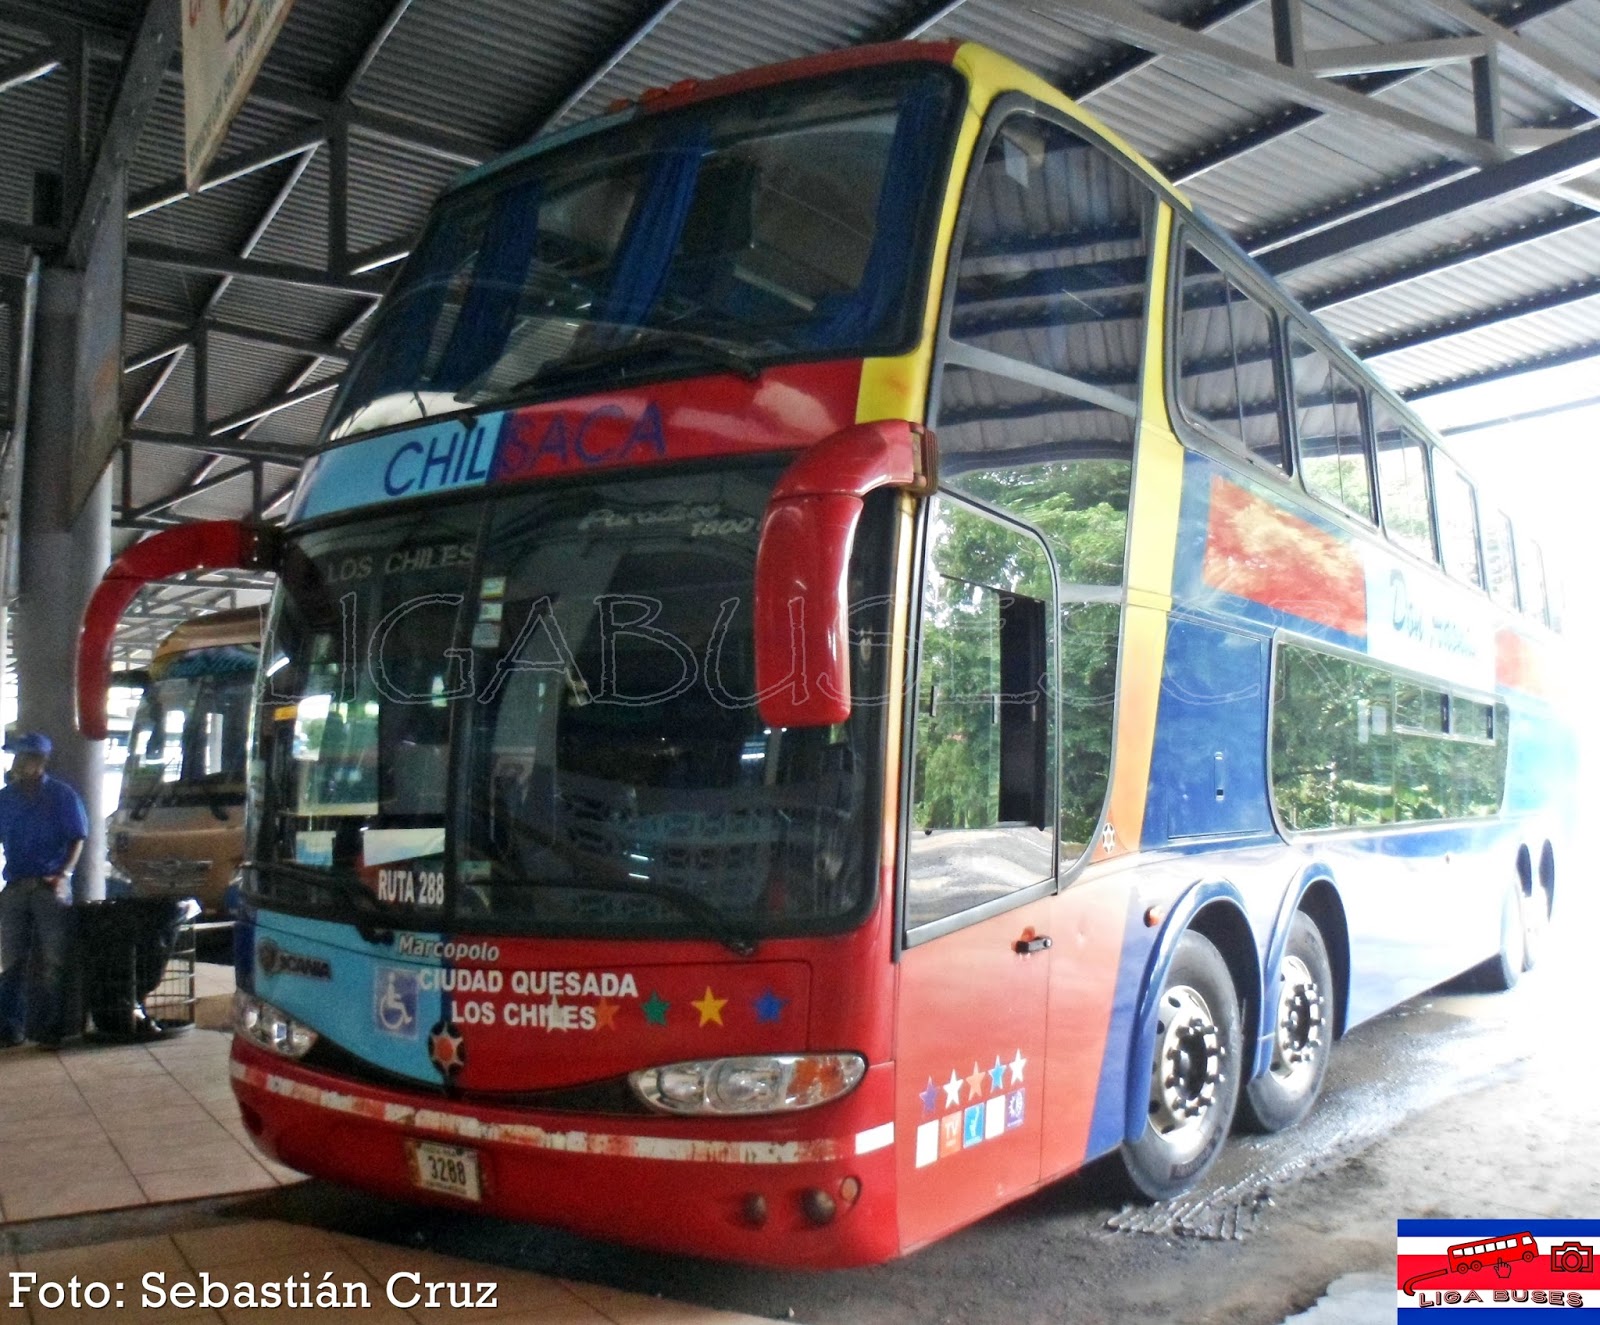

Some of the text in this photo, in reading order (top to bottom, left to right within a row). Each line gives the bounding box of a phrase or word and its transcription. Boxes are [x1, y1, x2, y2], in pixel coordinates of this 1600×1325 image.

[384, 402, 668, 497] CHILSACA
[325, 542, 478, 584] LOS CHILES
[378, 869, 445, 905] RUTA 288
[399, 934, 500, 962] Marcopolo
[417, 968, 639, 998] CIUDAD QUESADA
[450, 1000, 496, 1026] LOS
[427, 1155, 467, 1186] 3288
